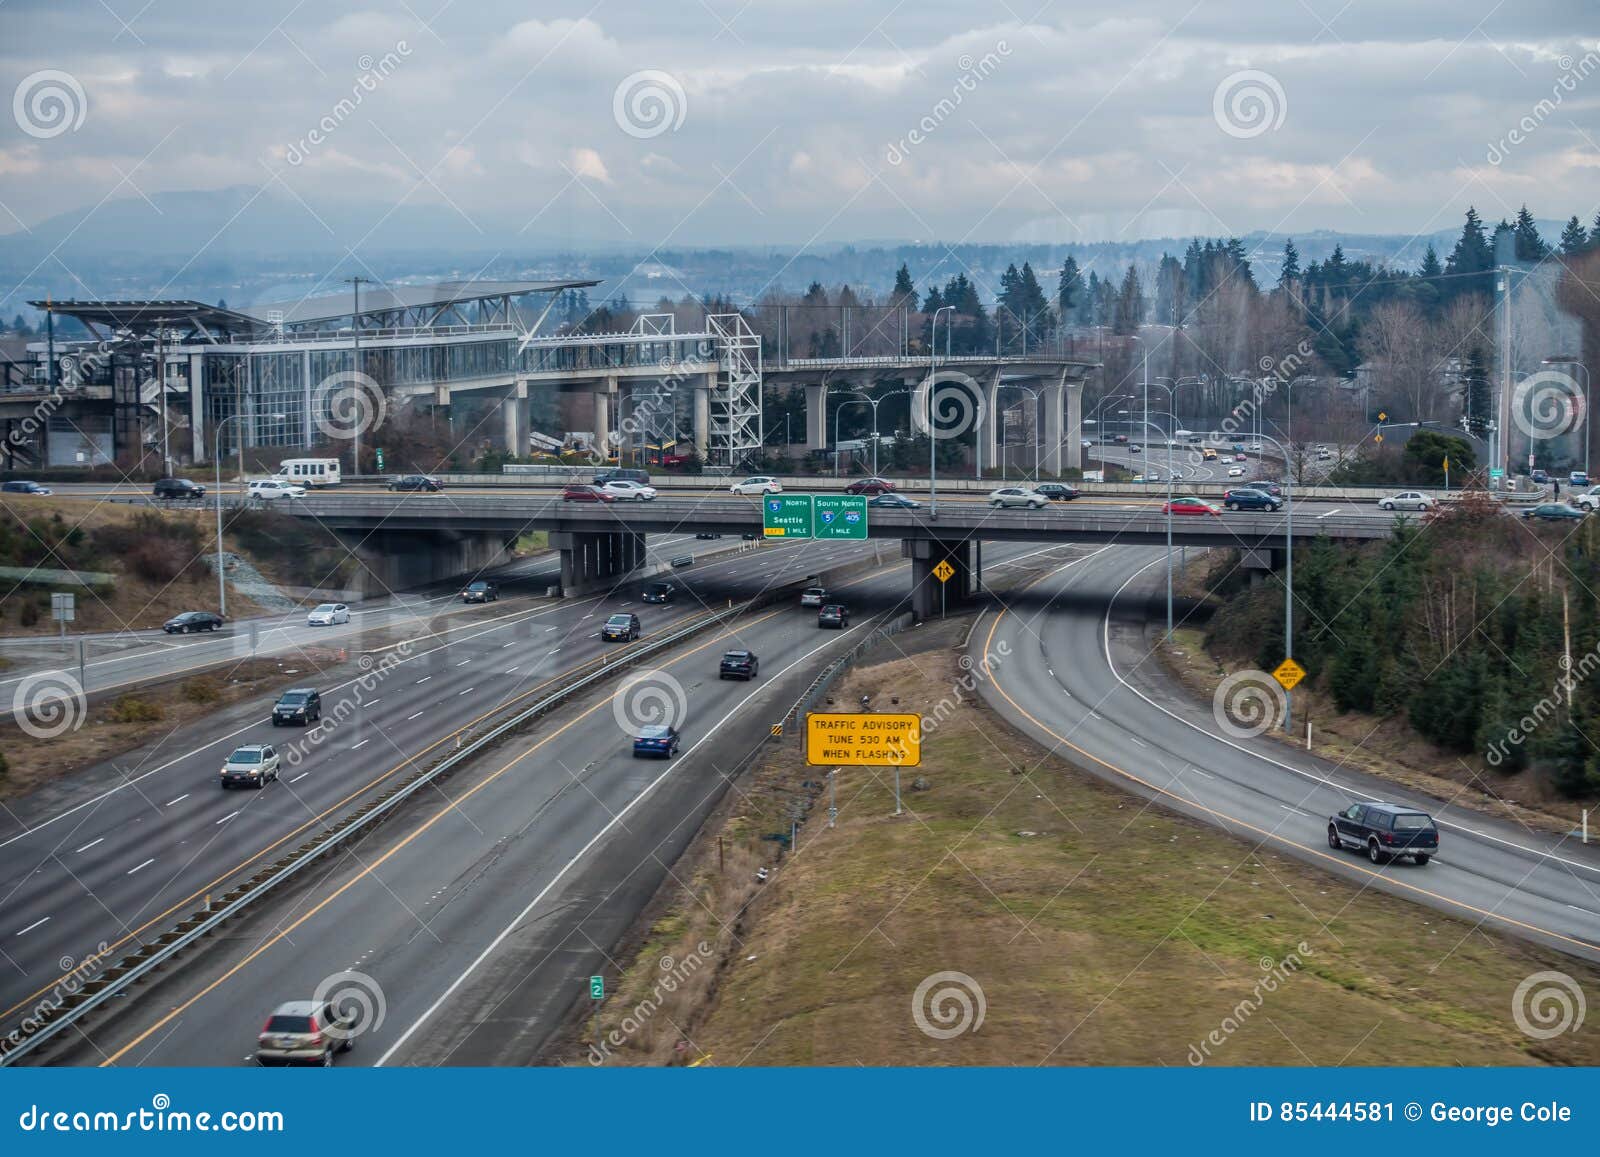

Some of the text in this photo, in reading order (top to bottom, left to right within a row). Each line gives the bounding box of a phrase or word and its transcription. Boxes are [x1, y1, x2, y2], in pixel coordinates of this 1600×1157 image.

[772, 503, 778, 511] 5
[773, 516, 803, 524] Seattle
[825, 514, 831, 522] 5
[815, 720, 913, 730] TRAFFIC ADVISORY
[828, 735, 900, 744] TUNE 530 AM
[823, 749, 850, 759] WHEN
[592, 985, 601, 996] 2
